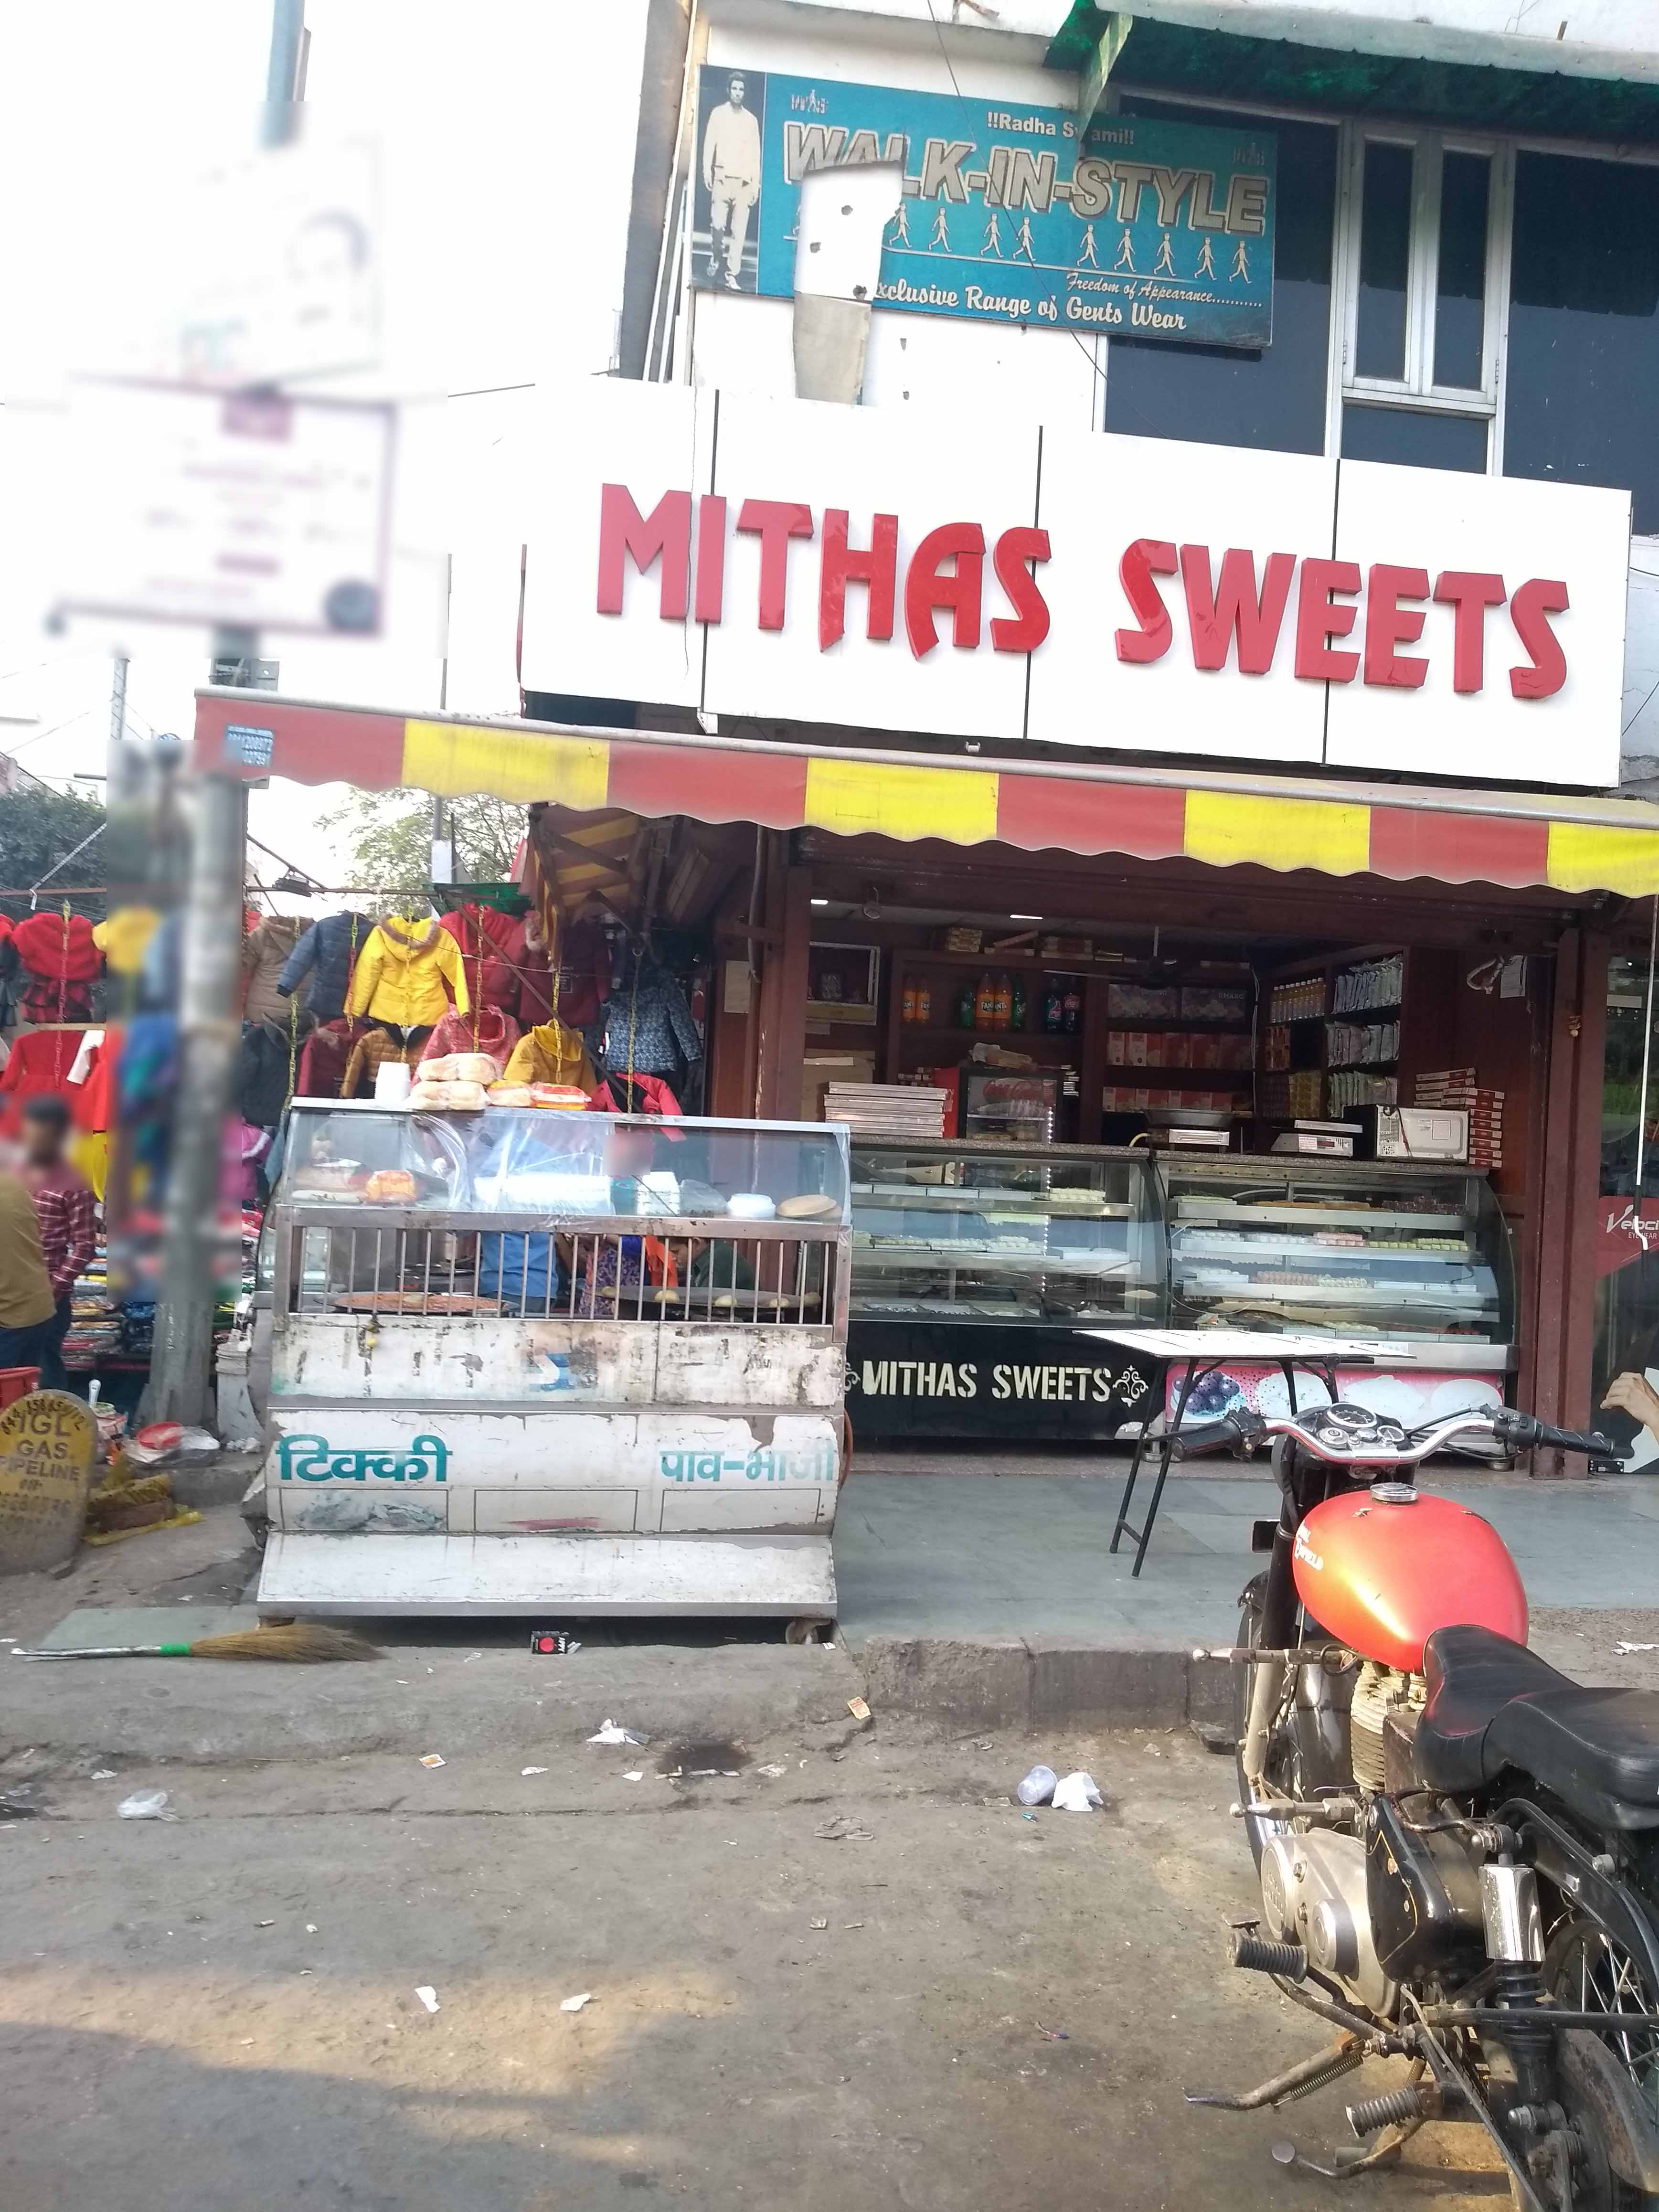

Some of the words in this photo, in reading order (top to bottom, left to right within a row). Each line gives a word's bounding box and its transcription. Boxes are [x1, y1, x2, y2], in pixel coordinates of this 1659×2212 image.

[1062, 121, 1135, 145] Sami!!
[874, 278, 959, 306] xclusive
[965, 285, 1032, 318] Range
[1037, 295, 1059, 321] of
[1065, 296, 1123, 325] Gents
[1130, 302, 1187, 330] Wear
[1065, 272, 1120, 293] Freedom
[1123, 281, 1137, 300] of
[596, 482, 1051, 661] MITHAS
[1115, 538, 1570, 700] SWEETS
[862, 1360, 978, 1398] MITHAS
[991, 1364, 1112, 1402] SWEETS
[17, 1439, 69, 1460] GAS
[275, 1433, 453, 1482] टिक्की
